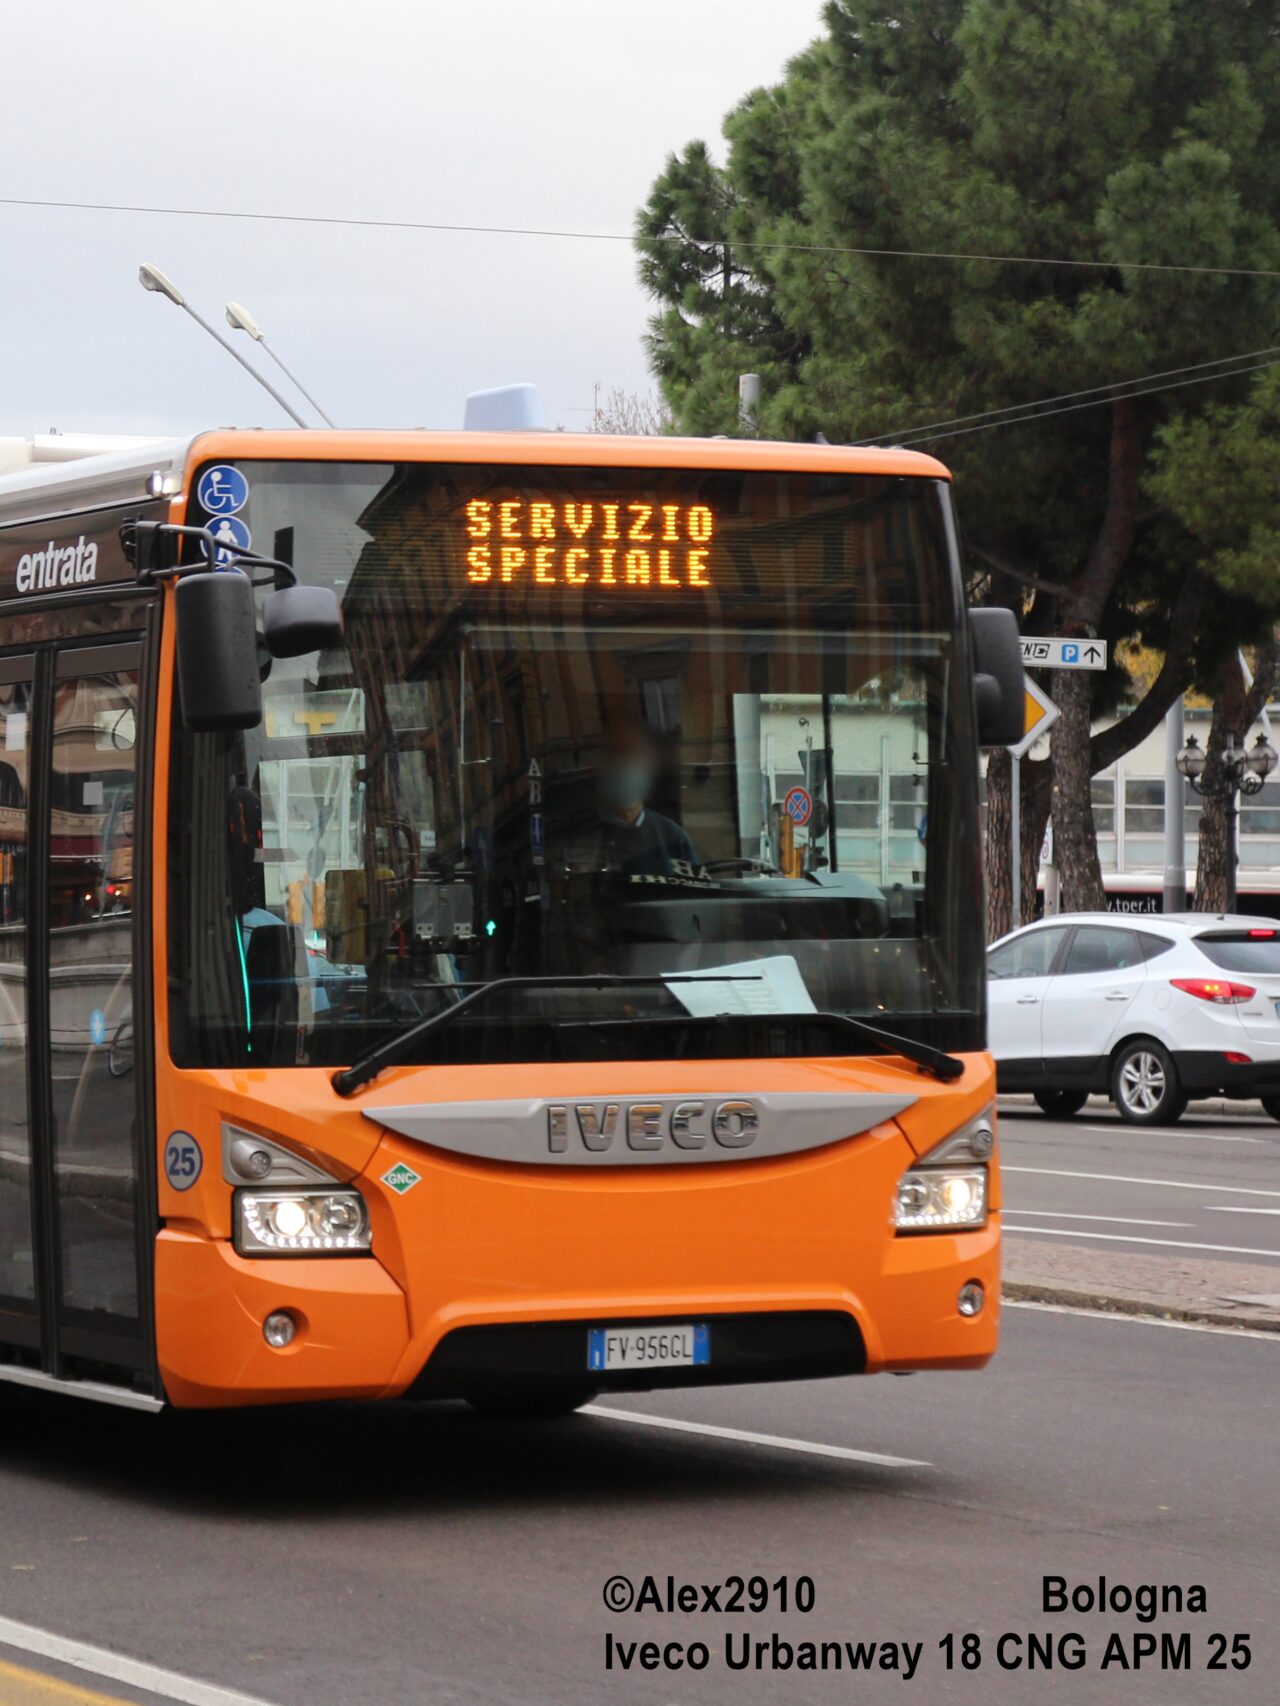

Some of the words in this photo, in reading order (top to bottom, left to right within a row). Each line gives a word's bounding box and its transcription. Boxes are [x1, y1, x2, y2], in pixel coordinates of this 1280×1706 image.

[467, 501, 713, 542] SERVIZIO
[16, 535, 99, 593] entrata
[467, 547, 710, 585] SPECIALE
[547, 1100, 761, 1154] IVECO
[168, 1146, 196, 1177] 25
[388, 1172, 415, 1185] GNC
